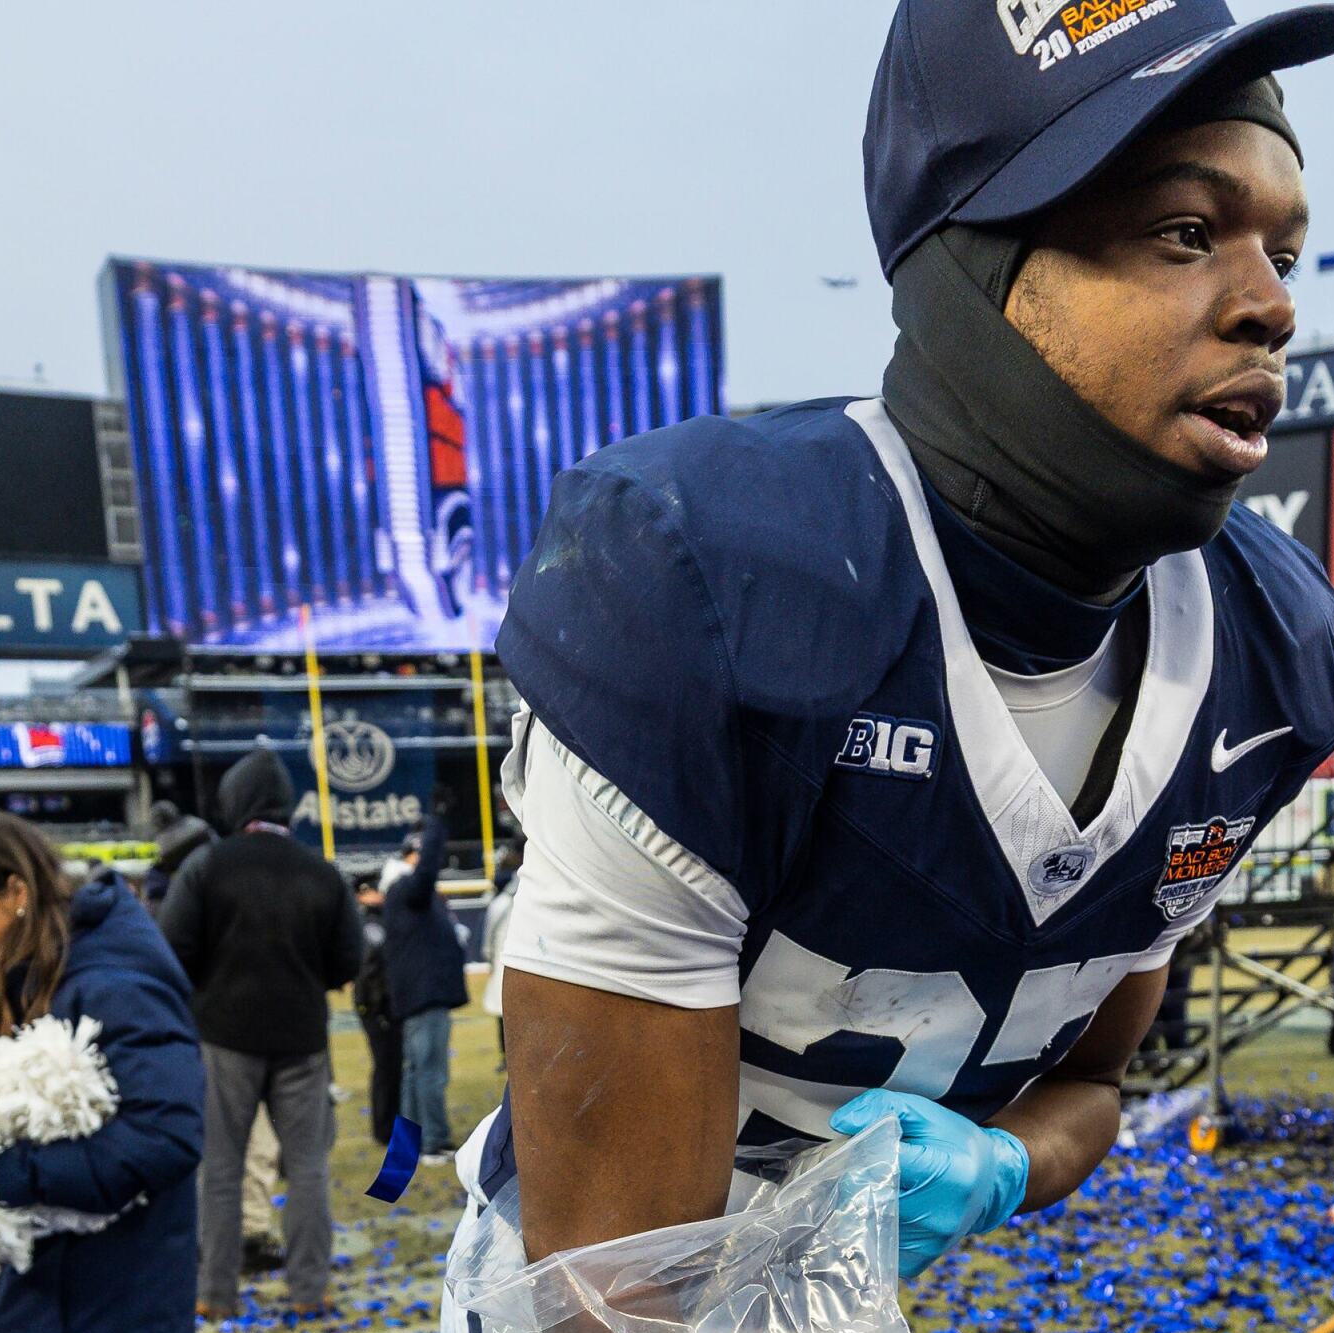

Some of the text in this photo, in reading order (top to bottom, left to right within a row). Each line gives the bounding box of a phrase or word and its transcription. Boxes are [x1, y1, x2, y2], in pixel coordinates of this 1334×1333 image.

[1033, 29, 1072, 71] 20
[1068, 0, 1149, 43] MOWE
[1075, 11, 1141, 55] PINSTRIPE
[290, 790, 422, 830] Alstate
[1164, 861, 1229, 881] MOWERS
[1170, 845, 1236, 867] BAD BOY
